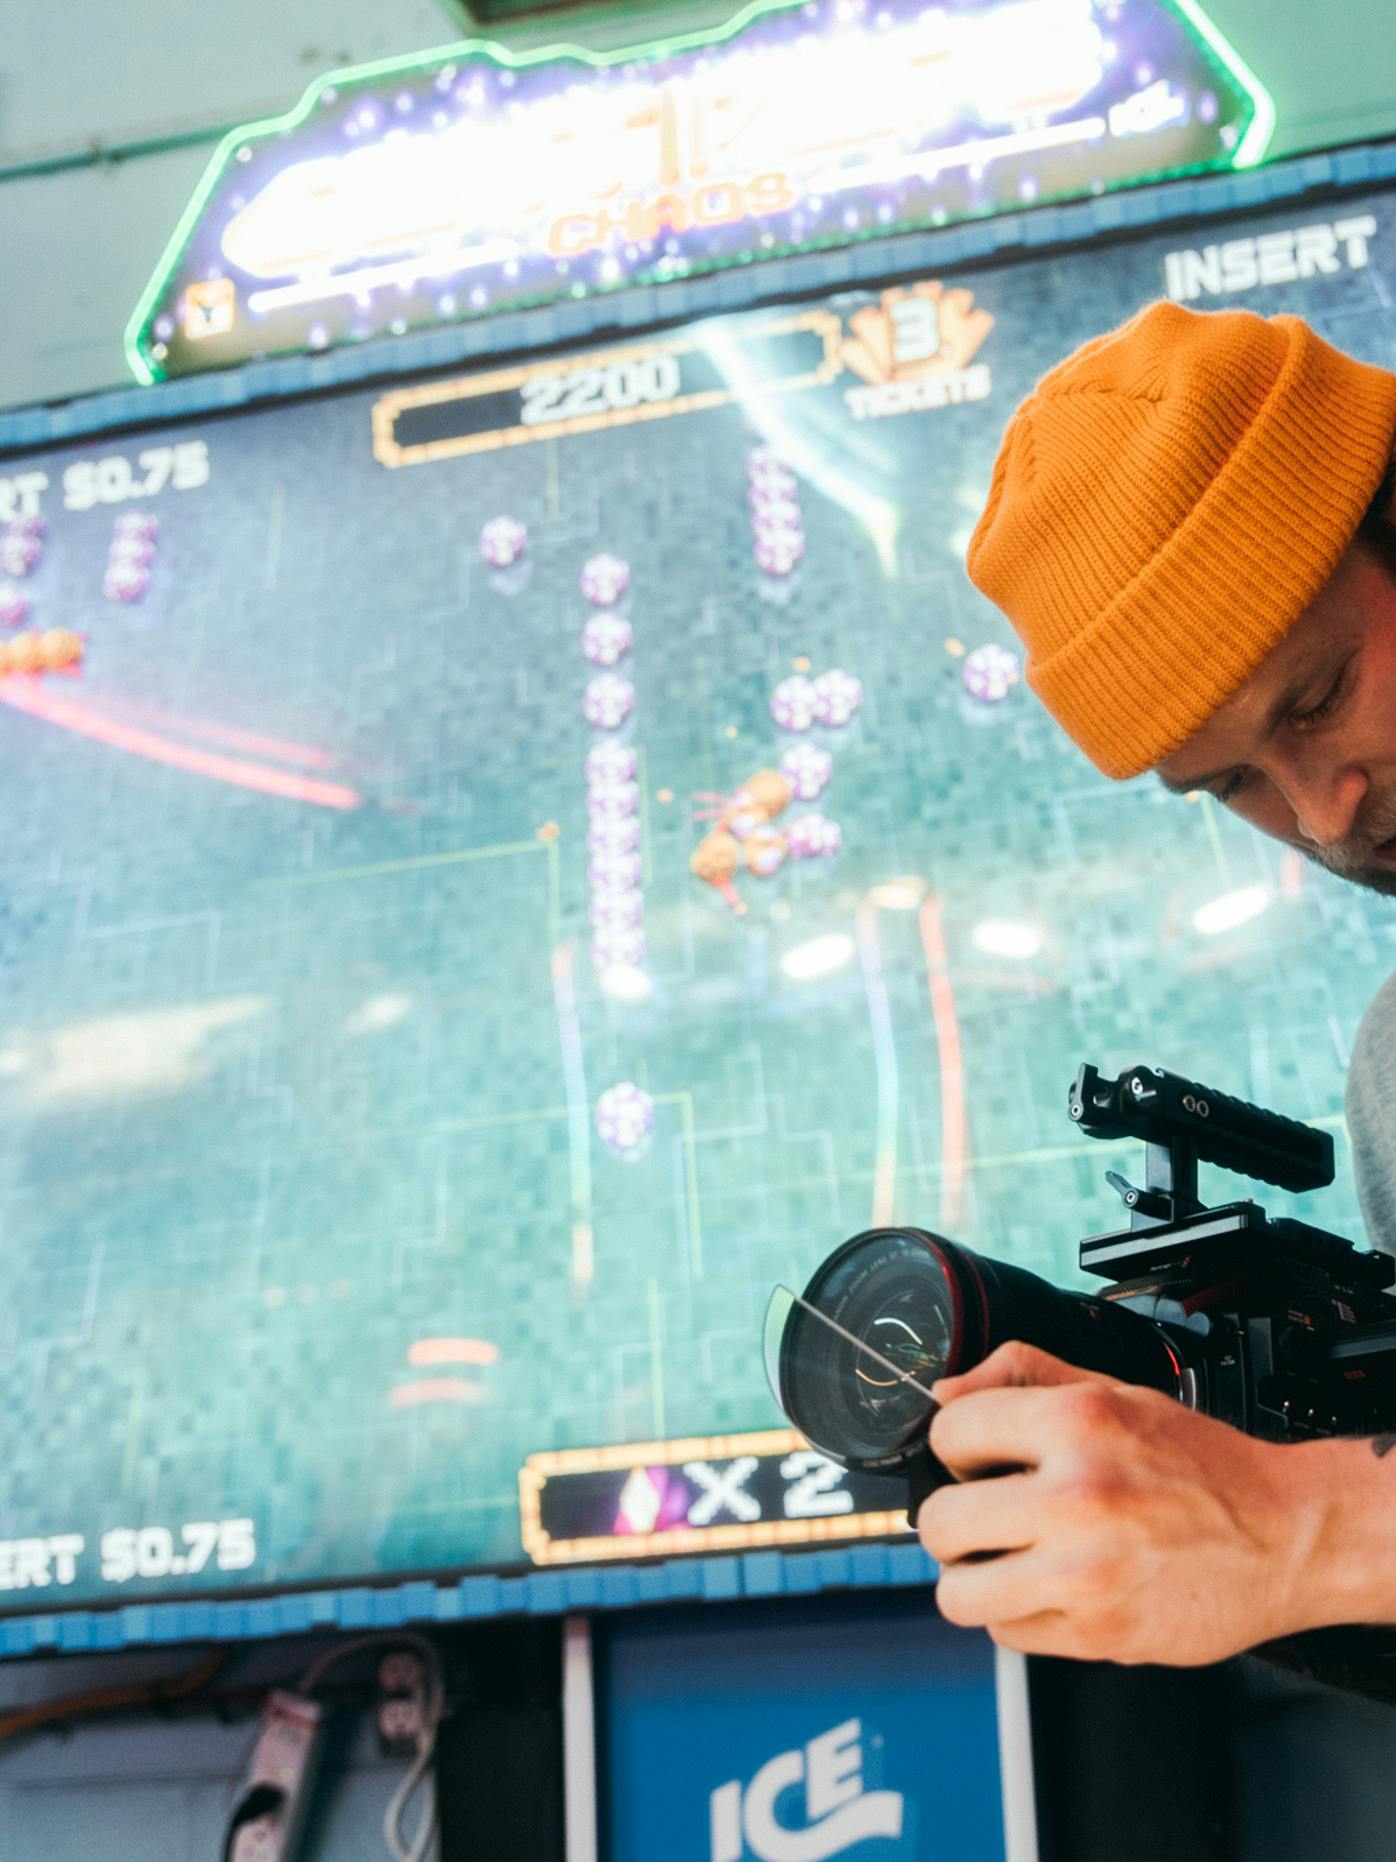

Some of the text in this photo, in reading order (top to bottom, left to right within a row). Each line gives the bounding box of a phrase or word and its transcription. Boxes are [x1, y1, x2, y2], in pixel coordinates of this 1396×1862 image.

[1164, 214, 1377, 301] INSERT
[891, 296, 940, 363] 3
[519, 353, 681, 425] 2200
[62, 440, 210, 512] $0.75
[683, 1450, 854, 1525] X 2
[101, 1518, 256, 1582] $0.75
[710, 1717, 904, 1862] ICE
